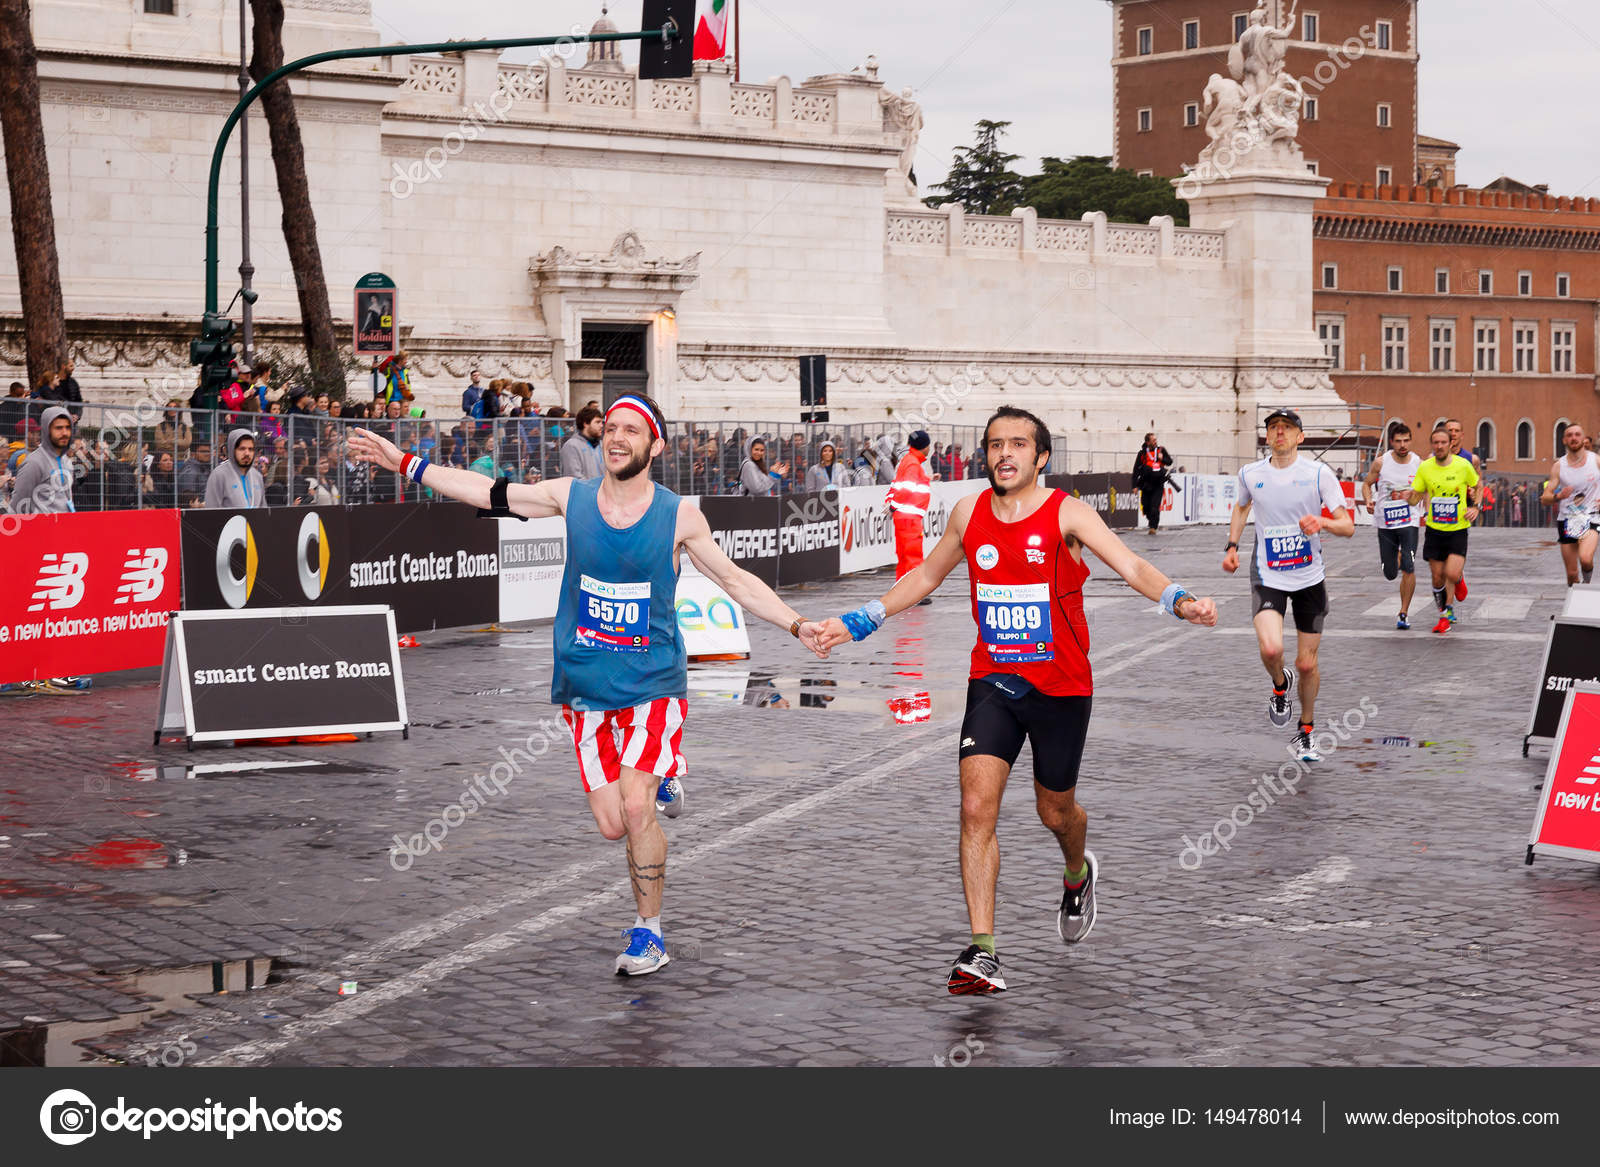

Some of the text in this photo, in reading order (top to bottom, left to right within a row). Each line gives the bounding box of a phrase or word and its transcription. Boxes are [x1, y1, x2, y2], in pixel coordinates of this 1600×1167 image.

[779, 520, 840, 556] POWERADE
[1272, 536, 1304, 553] 9132
[503, 542, 562, 563] FISH FACTOR
[350, 550, 498, 588] smart Center Roma
[103, 608, 170, 633] new balanc
[588, 596, 639, 624] 5570
[985, 605, 1042, 630] 4089
[14, 623, 43, 642] new
[600, 622, 615, 632] RAUL
[193, 660, 391, 684] smart Center Roma
[1554, 791, 1591, 809] new
